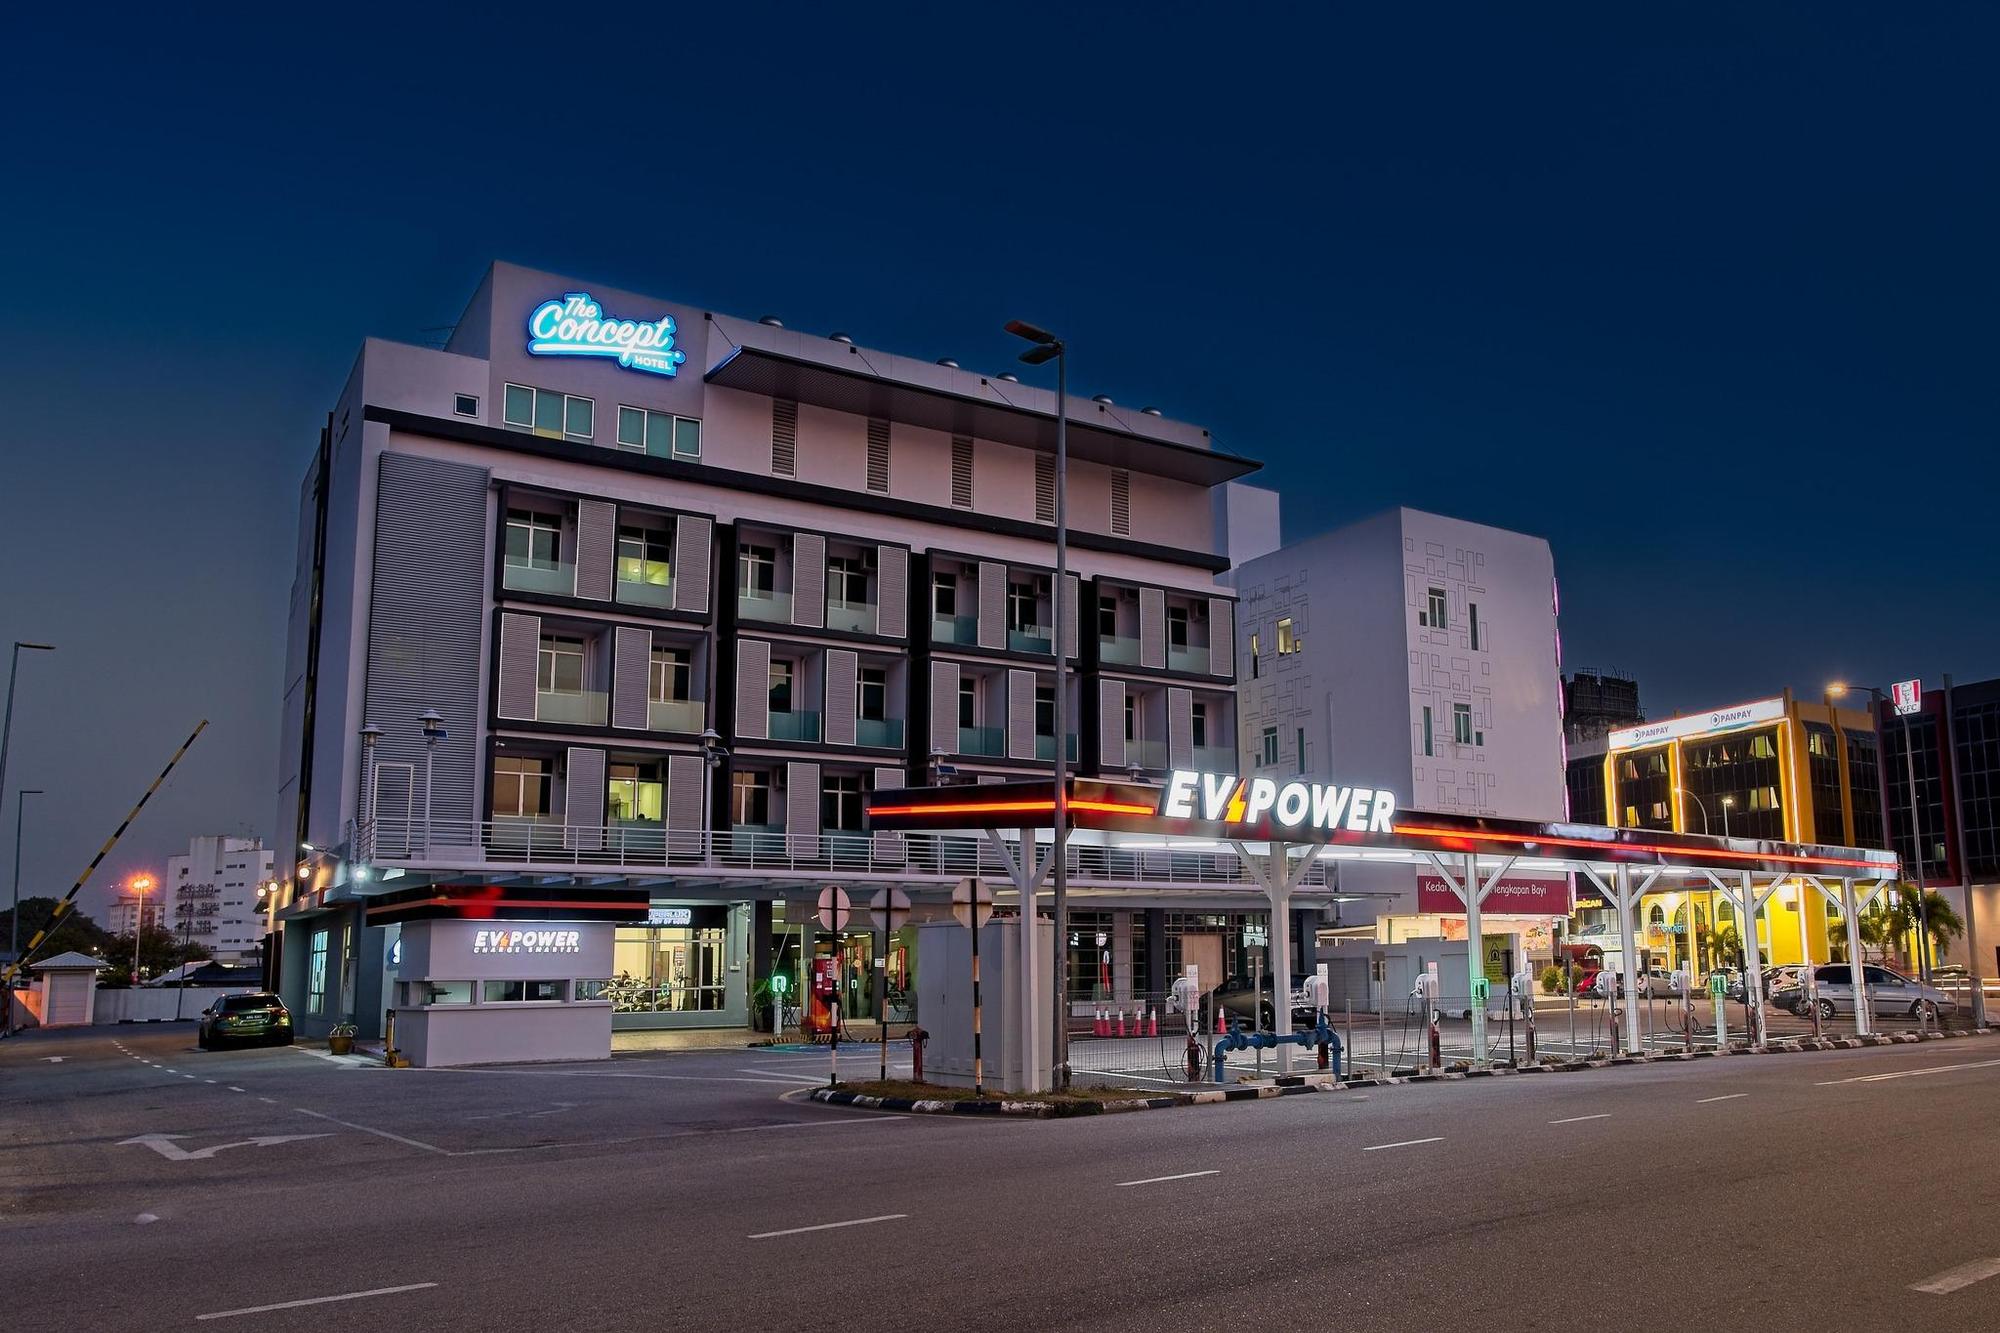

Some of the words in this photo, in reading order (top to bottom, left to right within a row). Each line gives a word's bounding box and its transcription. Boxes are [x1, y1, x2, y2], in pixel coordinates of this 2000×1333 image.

[565, 297, 598, 318] The
[533, 304, 671, 359] Concept
[635, 356, 671, 370] HOTEL
[1900, 704, 1917, 712] KFC
[1720, 710, 1752, 722] PANPAY
[1641, 726, 1669, 738] PANPAY
[1425, 881, 1447, 892] Kedai
[1482, 883, 1530, 896] lengkapan
[1531, 884, 1547, 897] Bayi
[473, 946, 520, 954] CHARGE
[528, 946, 580, 954] SMARTER
